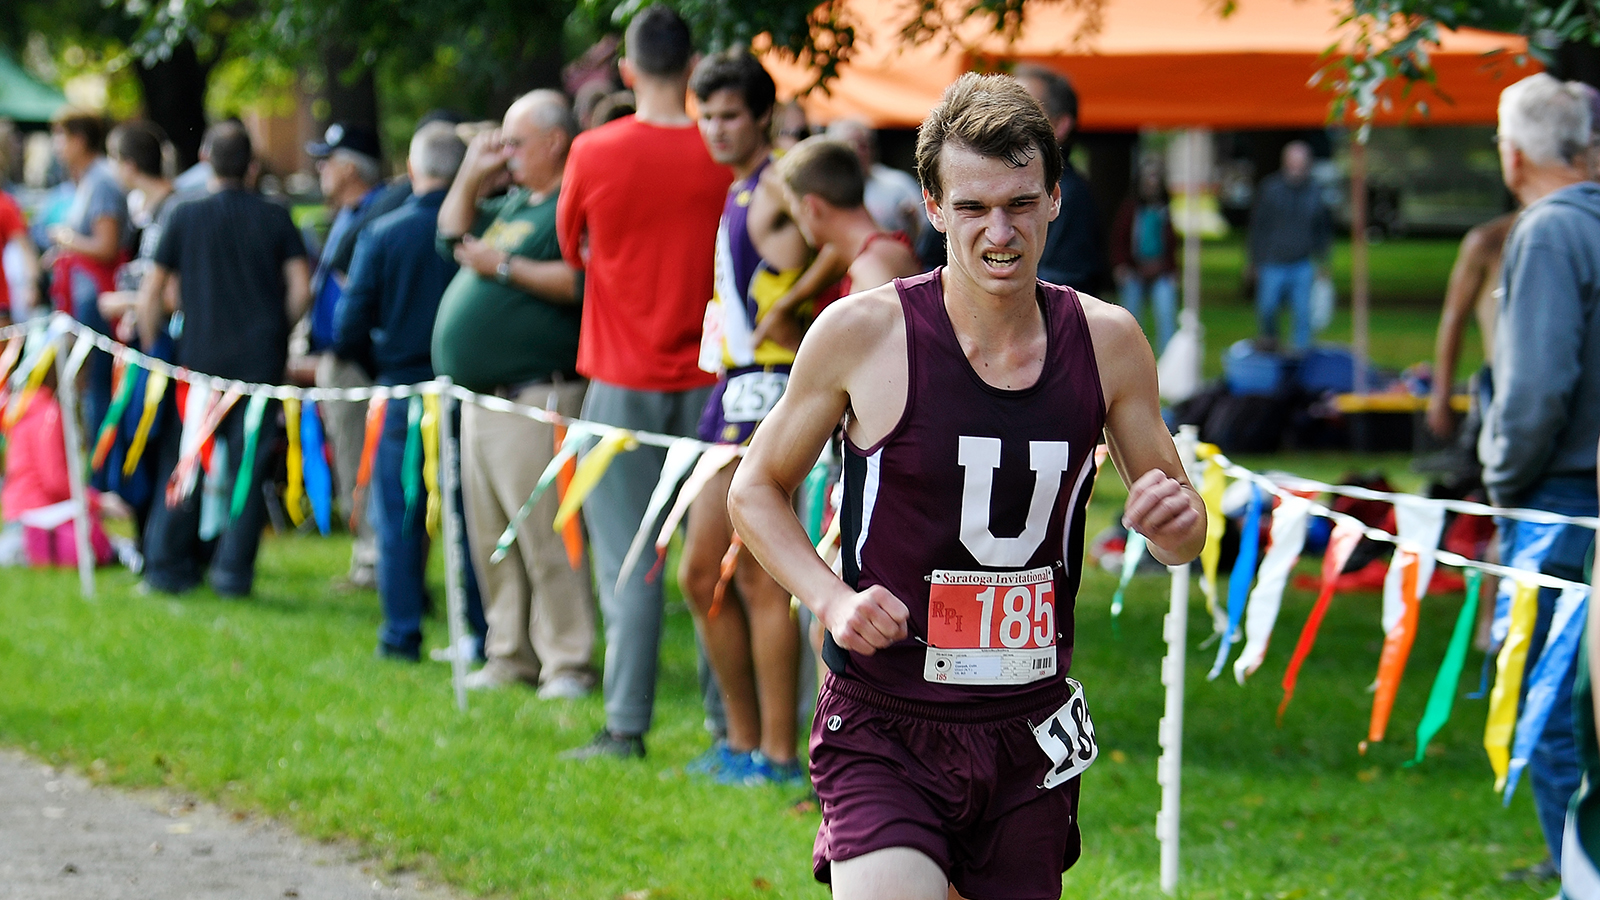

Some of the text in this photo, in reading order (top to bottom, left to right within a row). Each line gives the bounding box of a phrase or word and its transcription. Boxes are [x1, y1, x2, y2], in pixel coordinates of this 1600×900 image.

[958, 436, 1069, 567] U
[942, 568, 1049, 585] Saratoga Invitational
[932, 601, 963, 632] RPI
[976, 582, 1054, 648] 185
